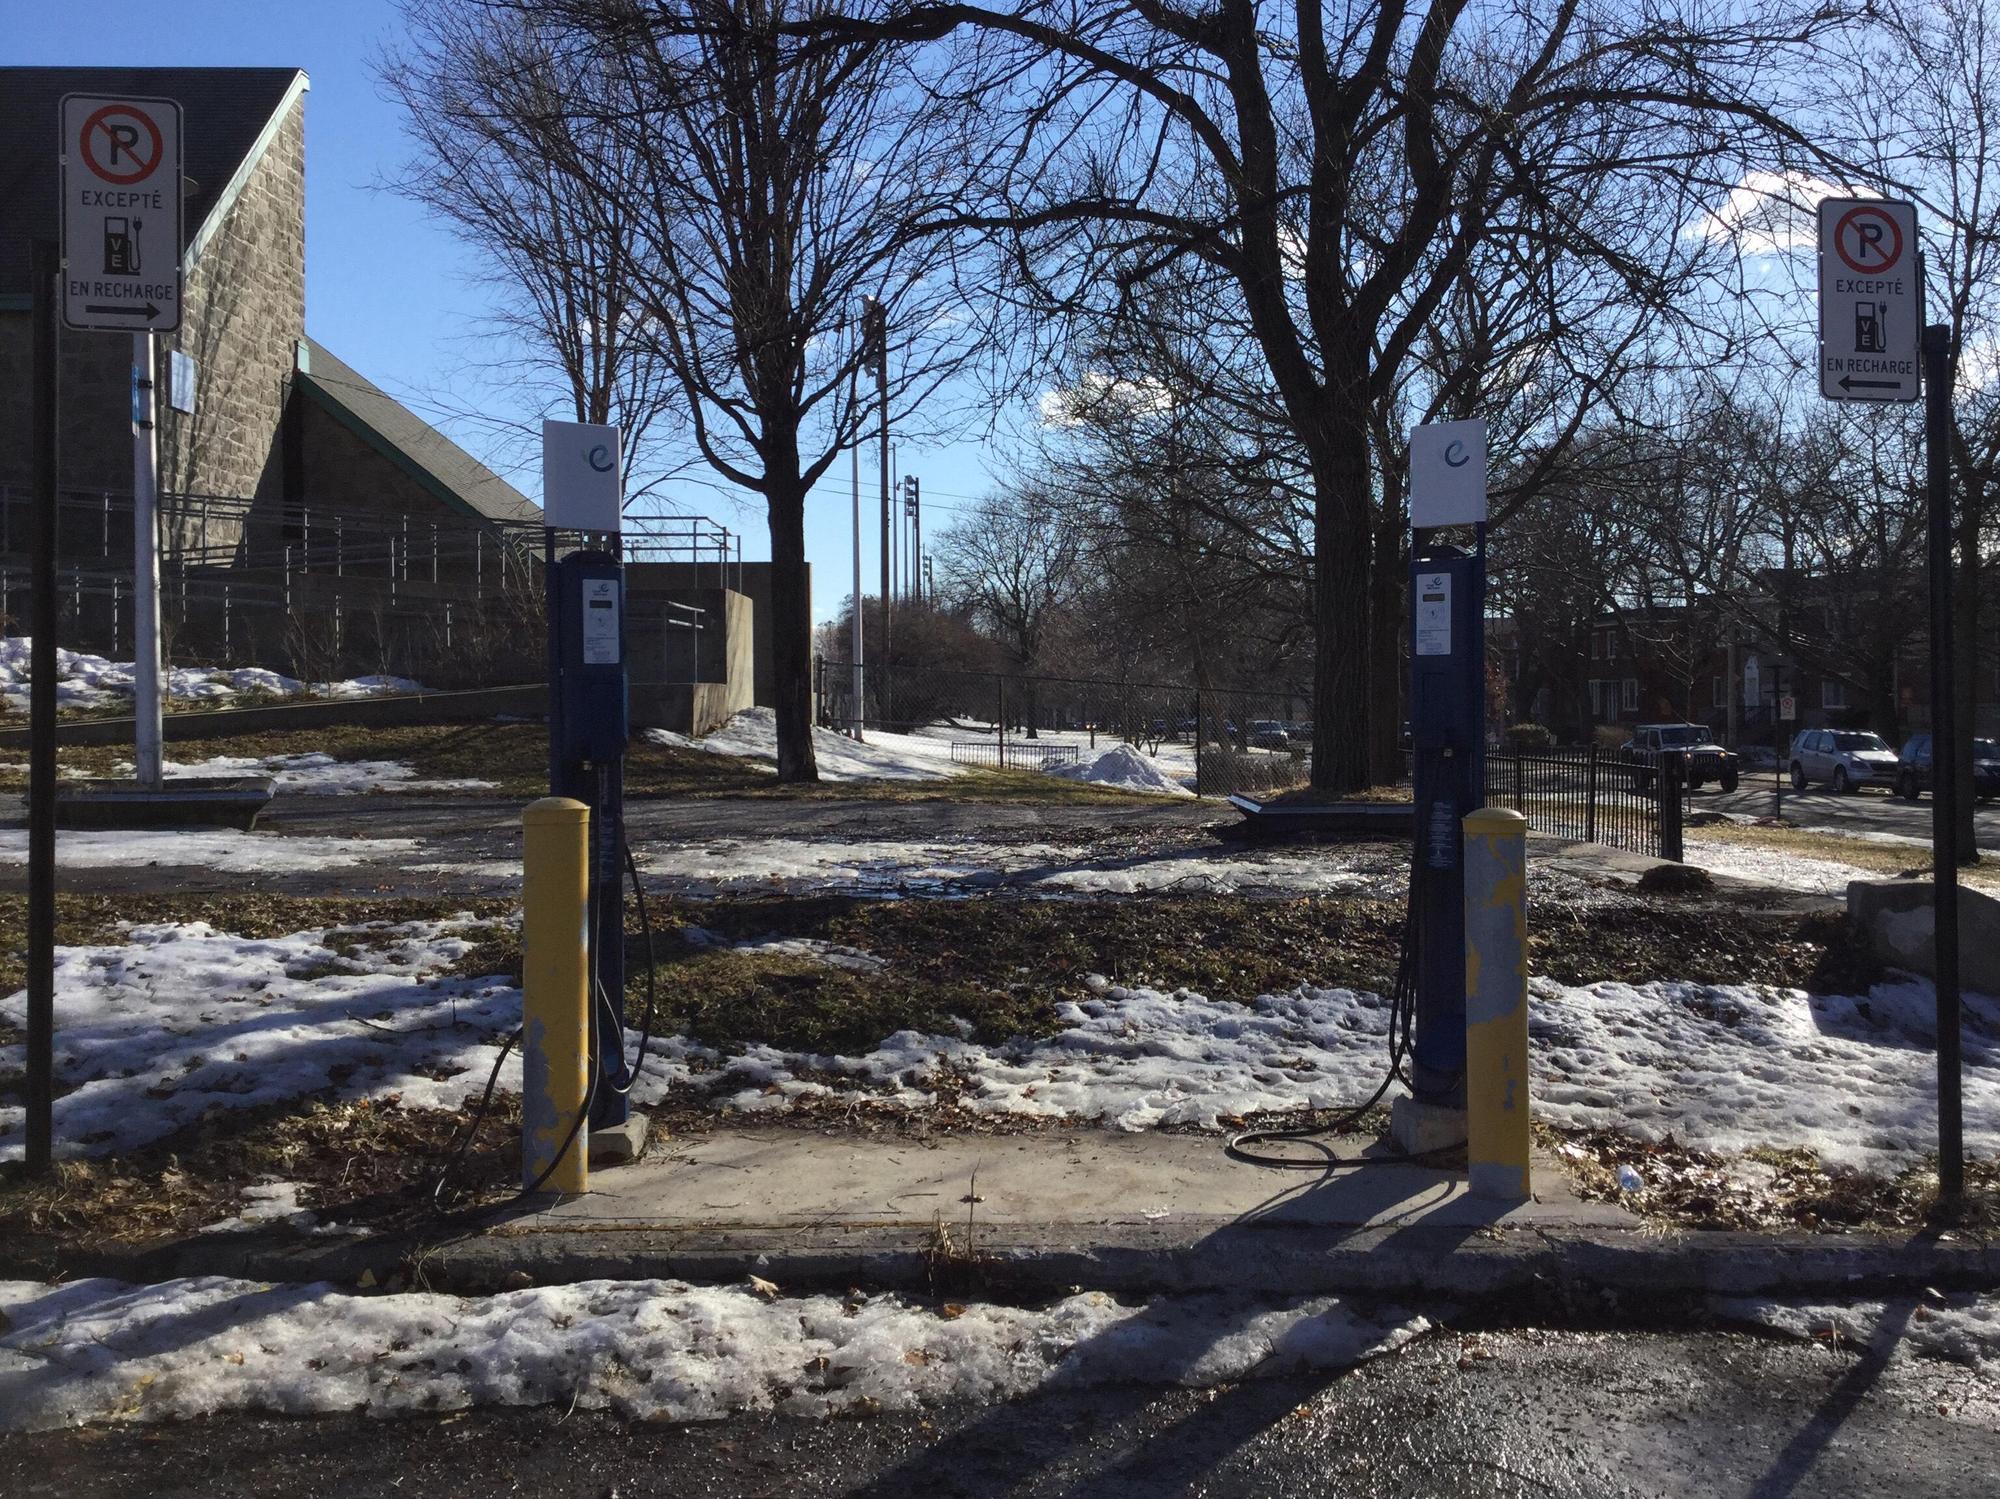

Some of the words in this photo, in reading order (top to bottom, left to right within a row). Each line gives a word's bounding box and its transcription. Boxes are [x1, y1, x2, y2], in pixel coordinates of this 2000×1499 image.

[110, 124, 139, 166] P
[81, 189, 163, 209] EXCEPTÉ
[1859, 223, 1883, 258] P
[70, 281, 89, 296] EN
[94, 281, 174, 300] RECHARGE
[1836, 277, 1904, 295] EXCEPTÉ
[1827, 358, 1843, 372] EN
[1847, 358, 1913, 375] RECHARGE
